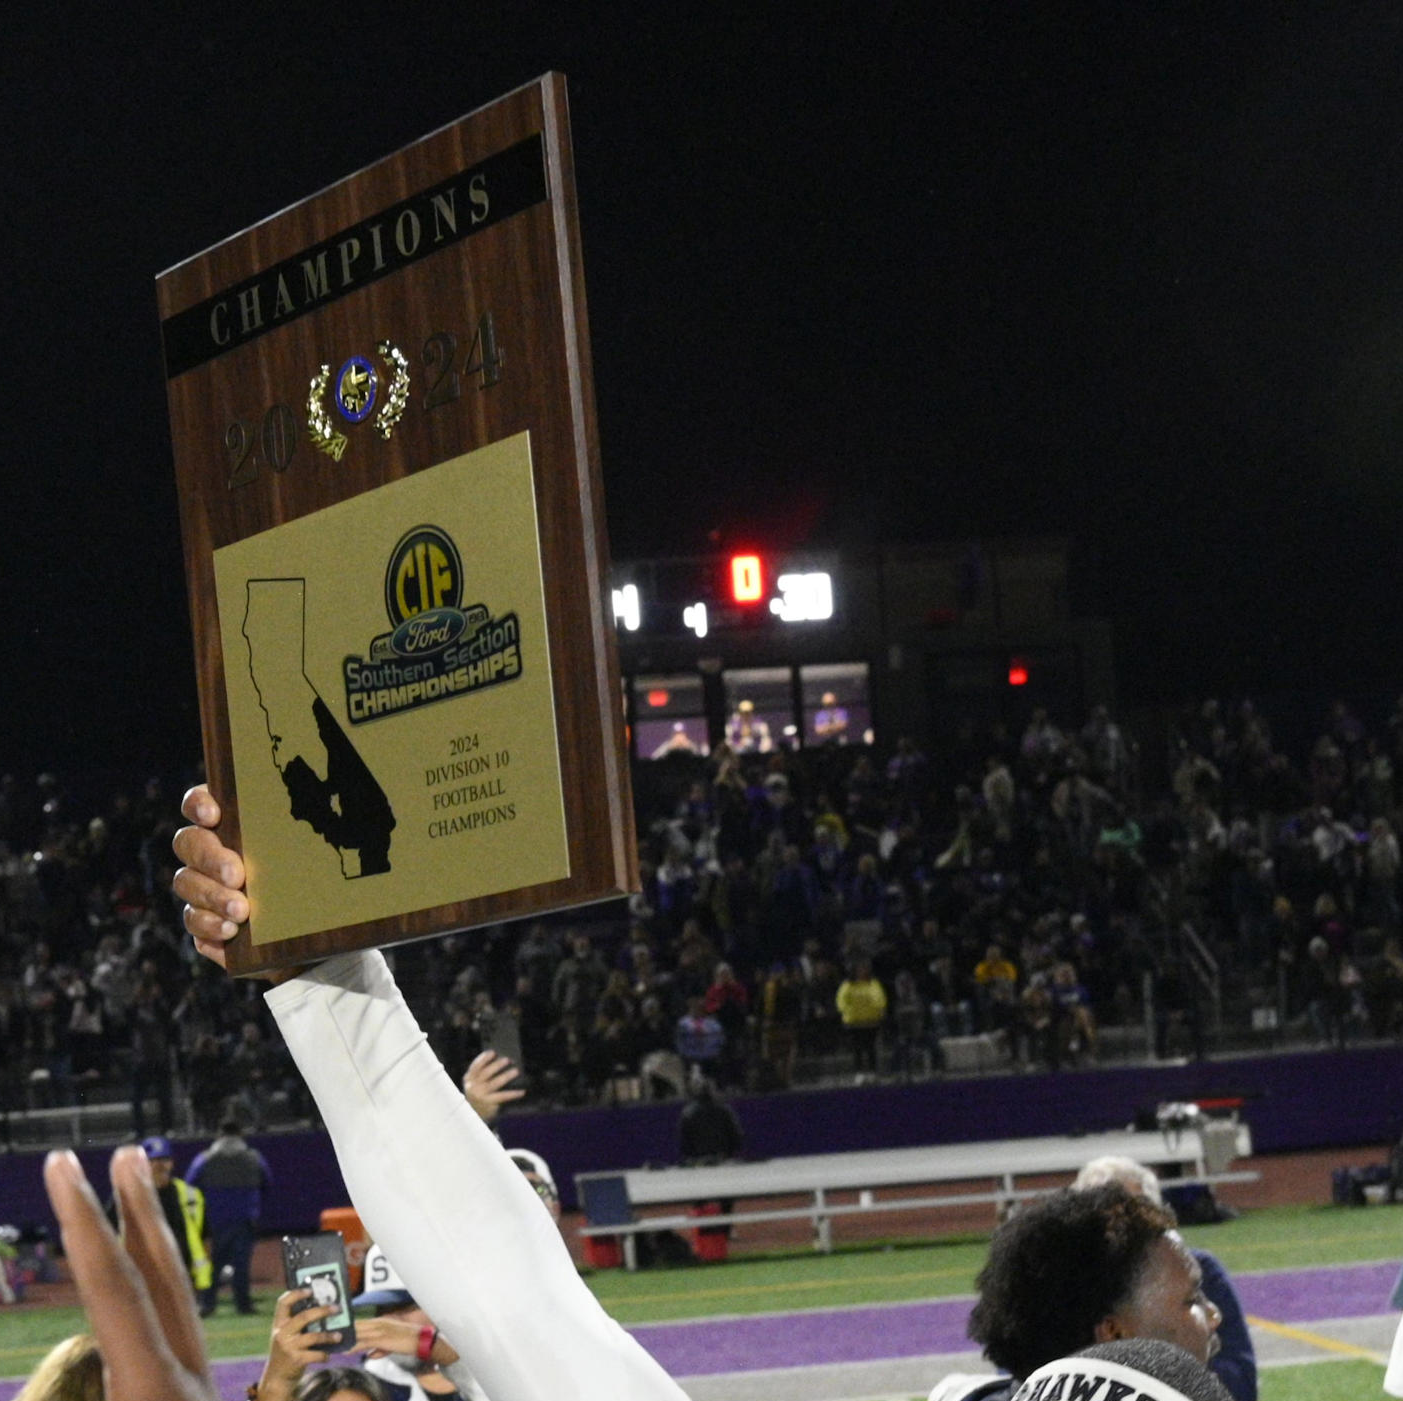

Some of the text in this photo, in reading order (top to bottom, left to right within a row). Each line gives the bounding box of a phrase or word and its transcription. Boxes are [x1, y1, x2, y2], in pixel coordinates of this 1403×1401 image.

[209, 174, 490, 346] CHAMPIONS
[224, 310, 504, 490] 20 24
[397, 542, 453, 621] CIF
[731, 554, 762, 602] 0
[346, 618, 516, 690] Southern Section
[405, 615, 451, 652] Ford
[349, 645, 519, 720] CHAMPIONSHIPS
[425, 750, 510, 786] DIVISION 10
[449, 733, 479, 756] 2024
[432, 778, 506, 811] FOOTBALL
[428, 803, 516, 839] CHAMPIONS
